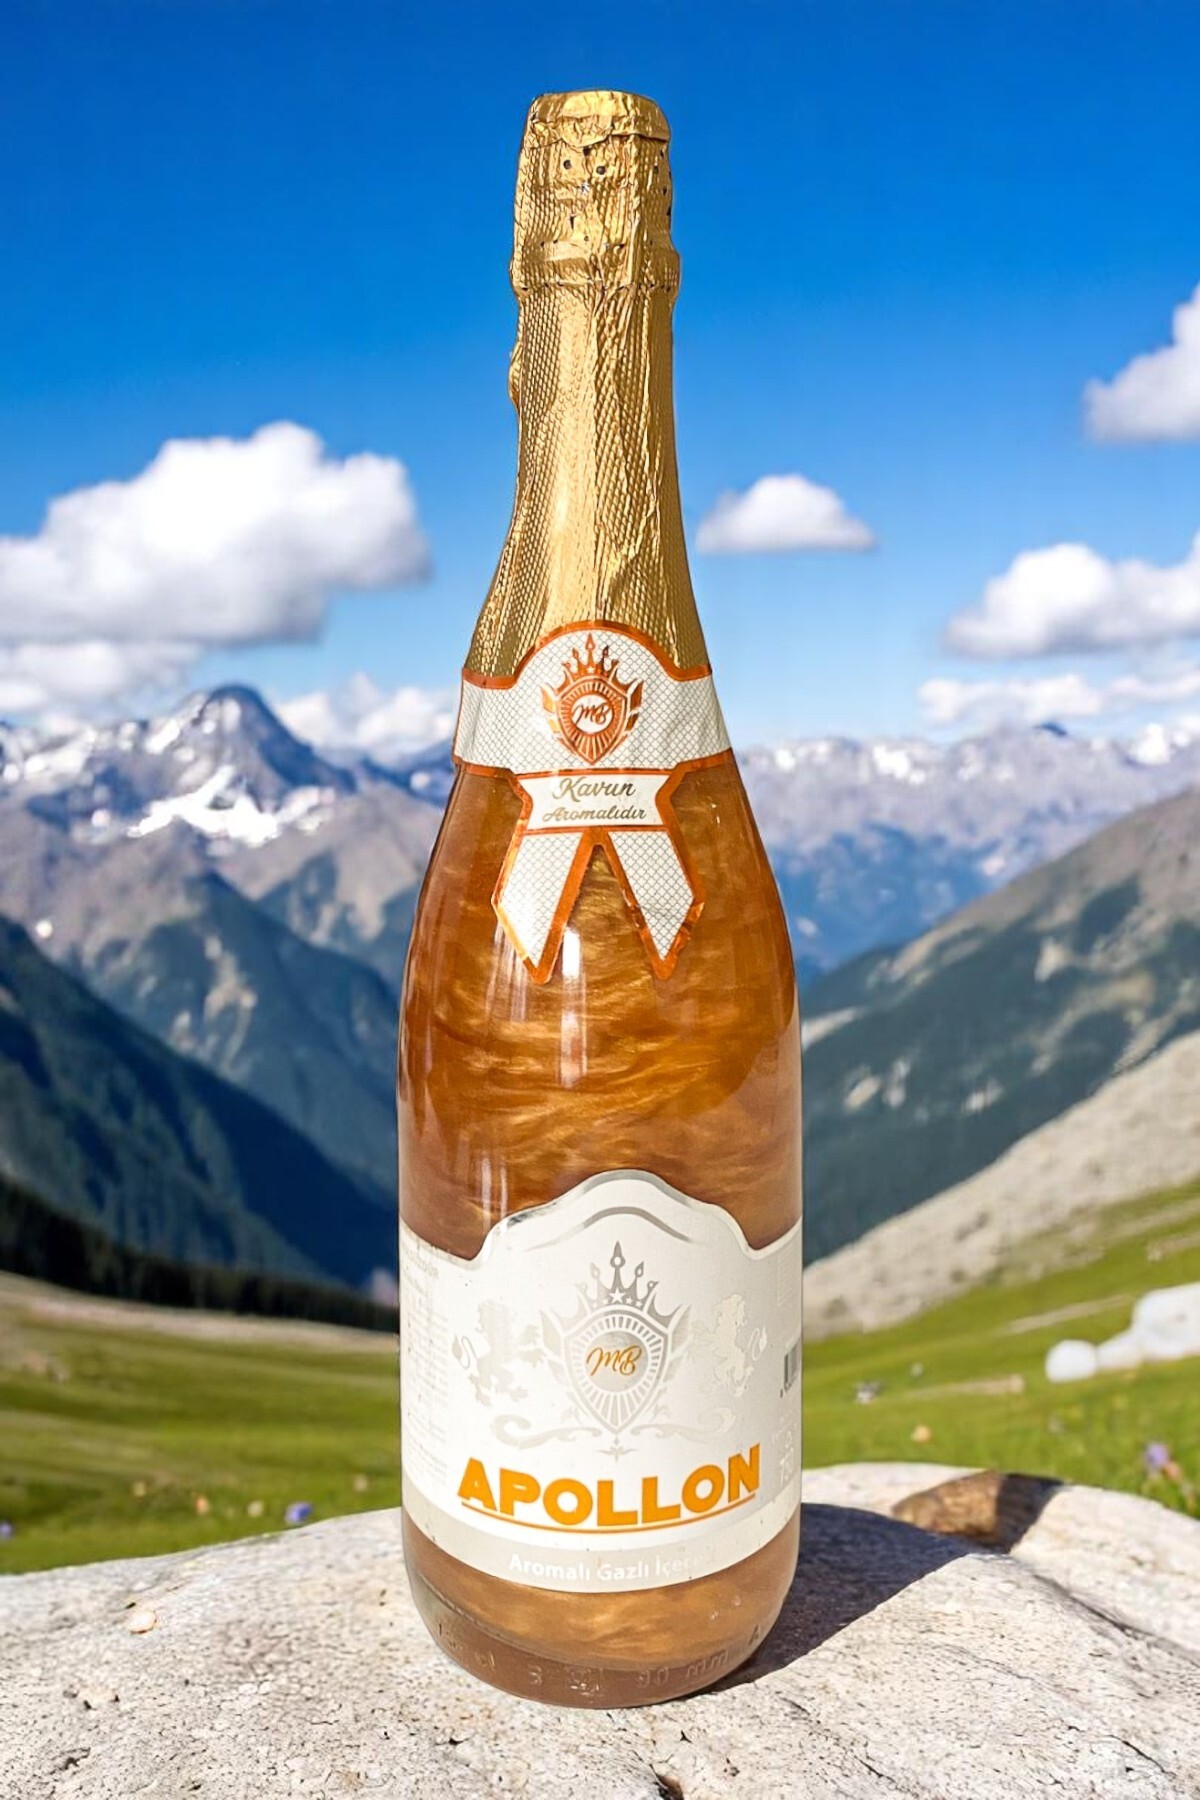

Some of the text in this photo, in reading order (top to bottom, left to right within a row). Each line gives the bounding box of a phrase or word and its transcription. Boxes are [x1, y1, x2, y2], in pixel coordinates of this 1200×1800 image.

[572, 702, 610, 725] MB
[552, 776, 637, 802] Kavun
[542, 805, 647, 822] Aromalıdır
[586, 1345, 641, 1376] MB
[457, 1443, 761, 1526] APOLLON
[508, 1553, 590, 1580] Aromalı
[597, 1563, 649, 1581] Gazlı
